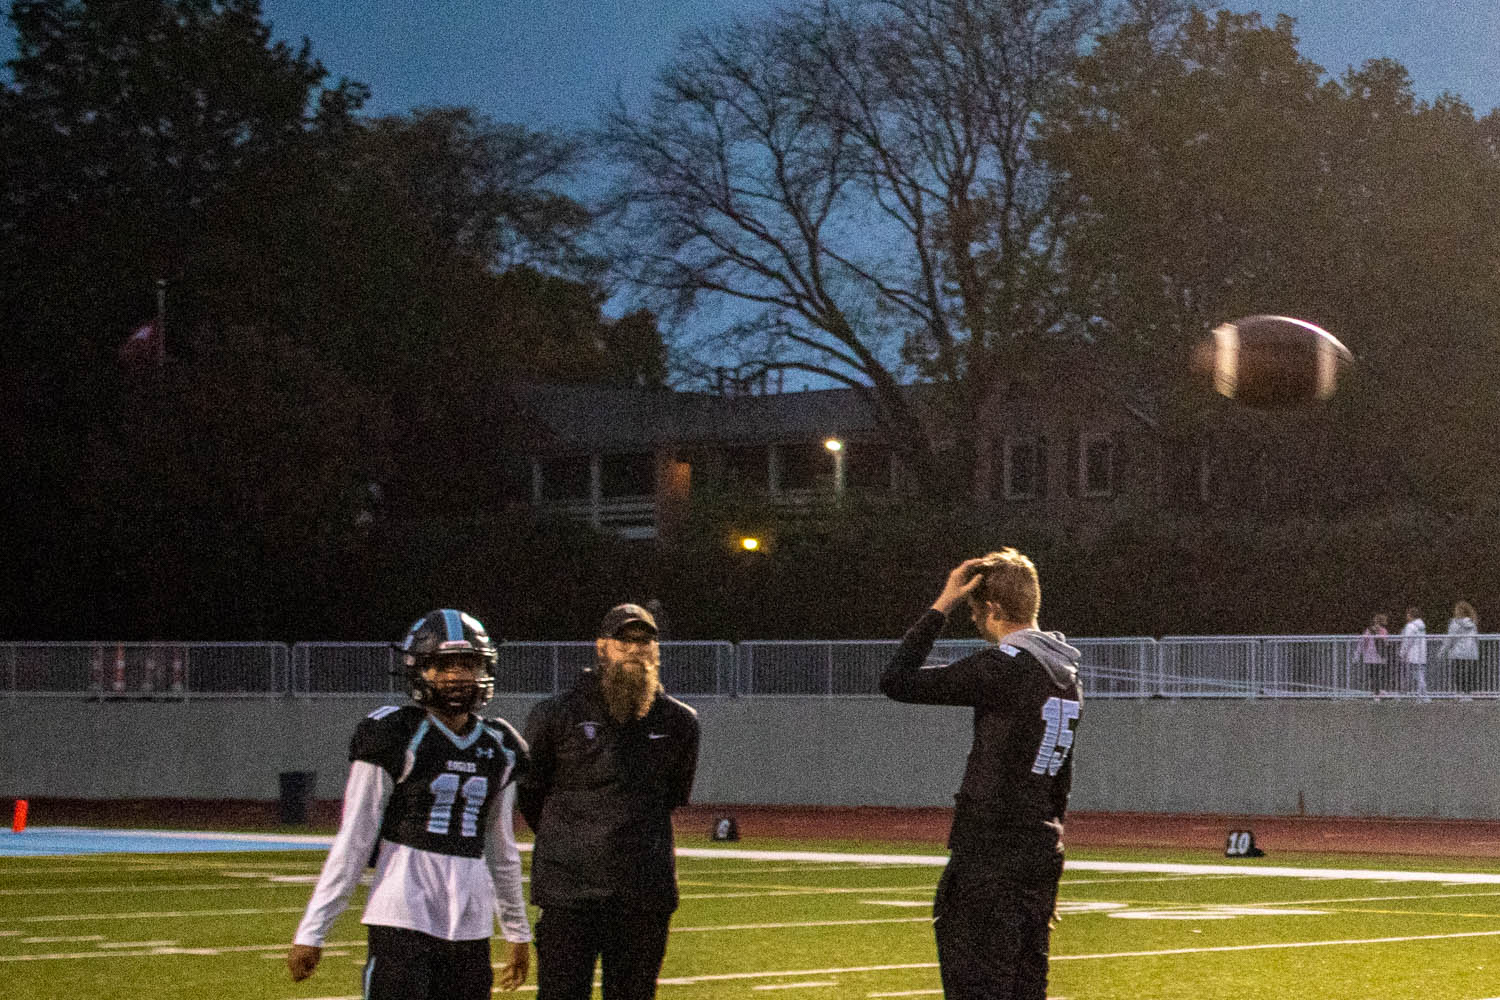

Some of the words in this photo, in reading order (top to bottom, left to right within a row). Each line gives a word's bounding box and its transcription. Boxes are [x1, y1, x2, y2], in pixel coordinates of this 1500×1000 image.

[1031, 697, 1080, 776] 15
[426, 773, 489, 837] 11
[1227, 832, 1250, 854] 10
